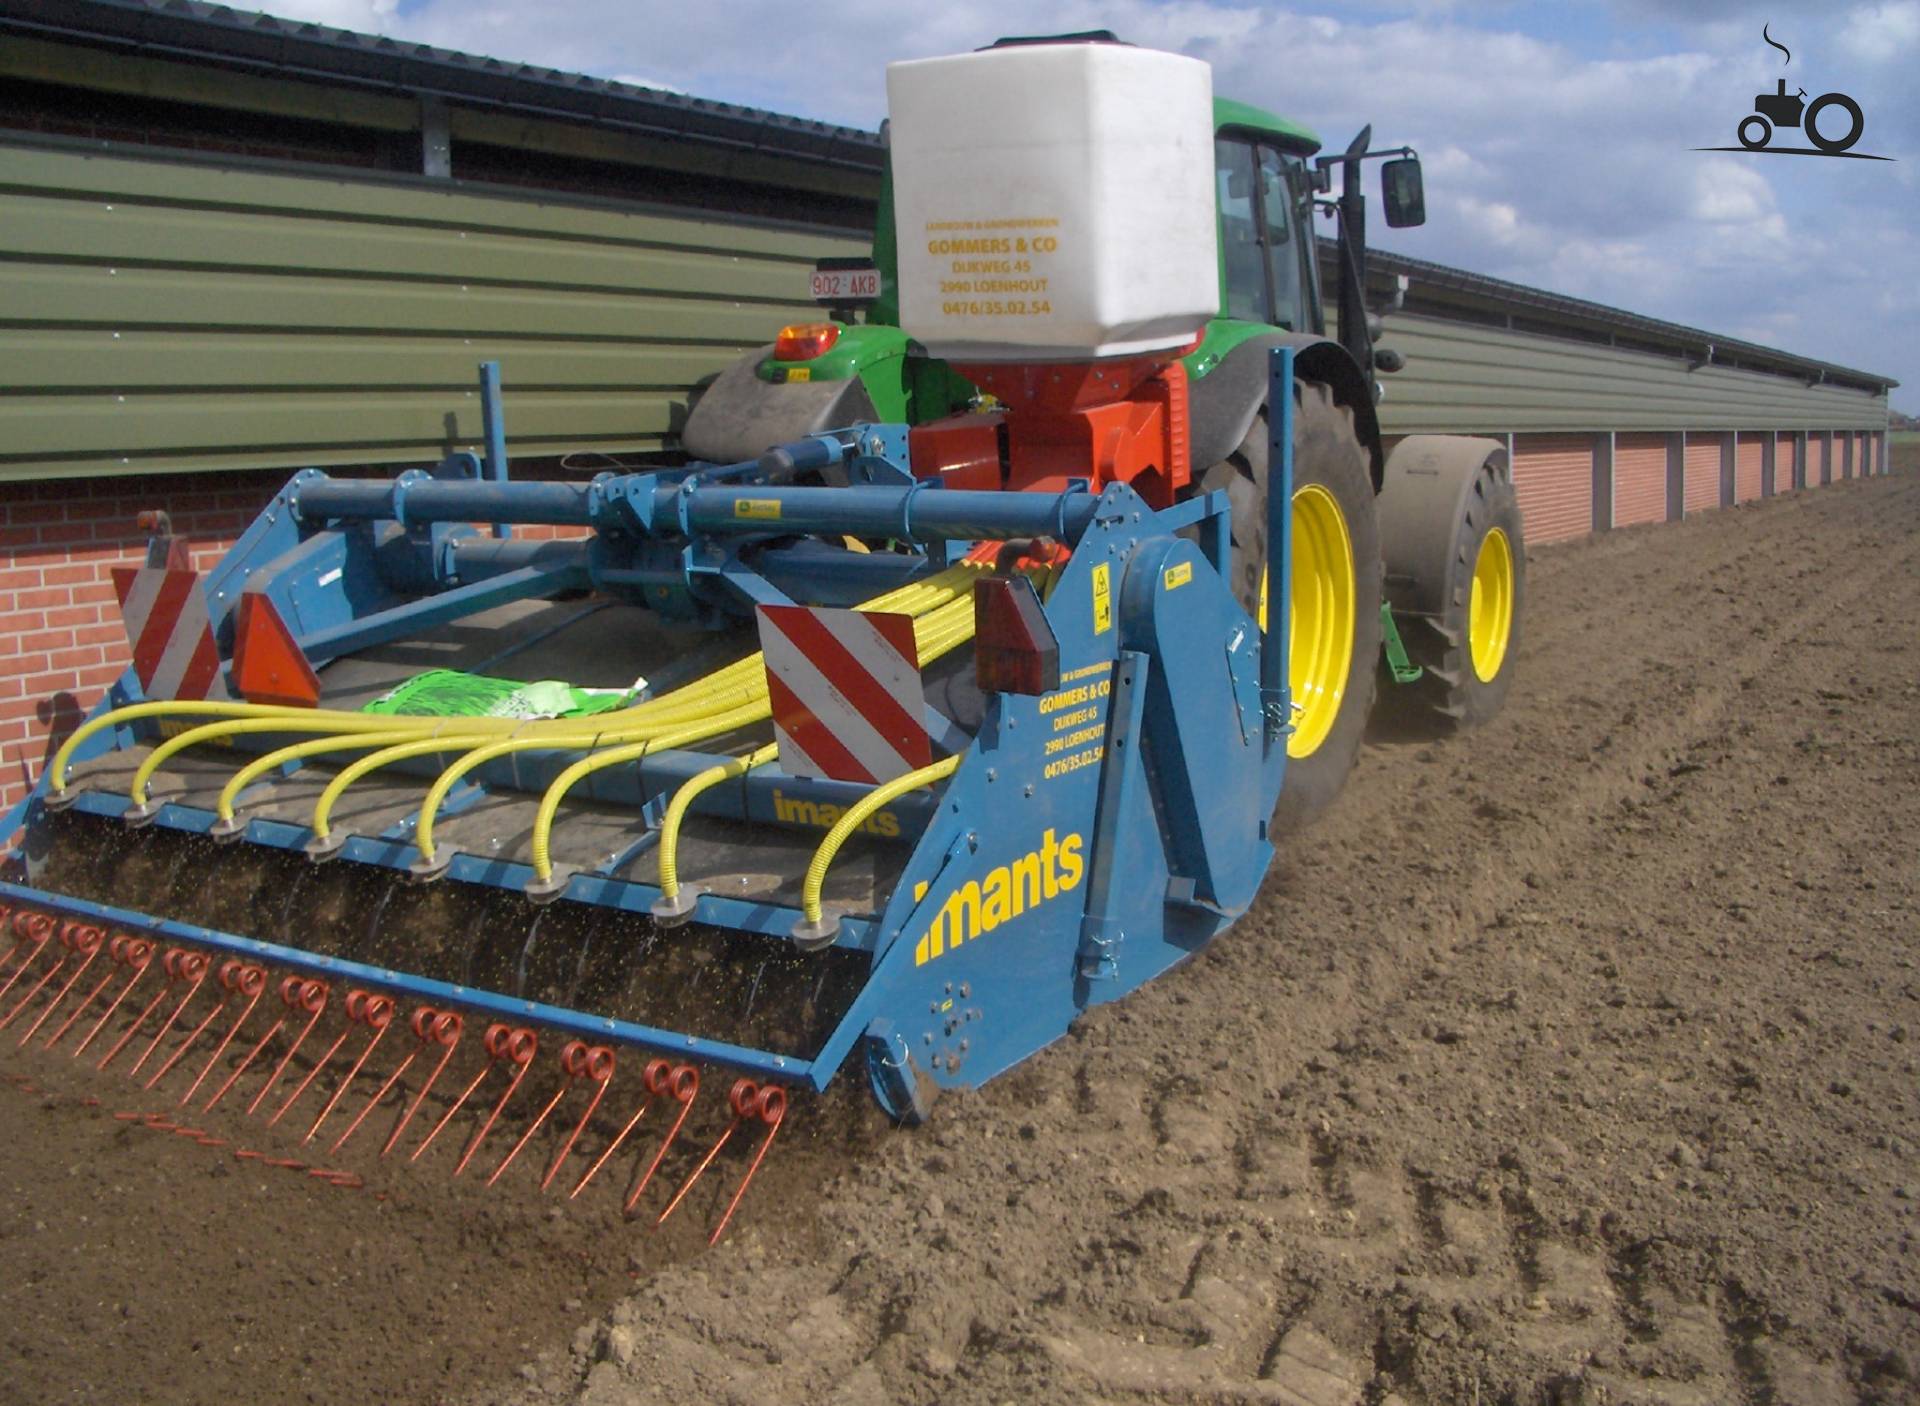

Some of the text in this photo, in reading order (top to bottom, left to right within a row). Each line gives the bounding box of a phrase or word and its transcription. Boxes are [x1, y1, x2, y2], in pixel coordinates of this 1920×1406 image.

[928, 237, 1057, 254] GOMMERS & CO
[1014, 260, 1031, 273] 45
[940, 279, 1048, 293] 2990 LOENHOUT
[1039, 680, 1110, 714] GOMMERS & CO
[1088, 706, 1097, 719] 45
[1064, 723, 1105, 748] LOENHOUT
[773, 789, 900, 837] imas
[914, 828, 1084, 967] imants
